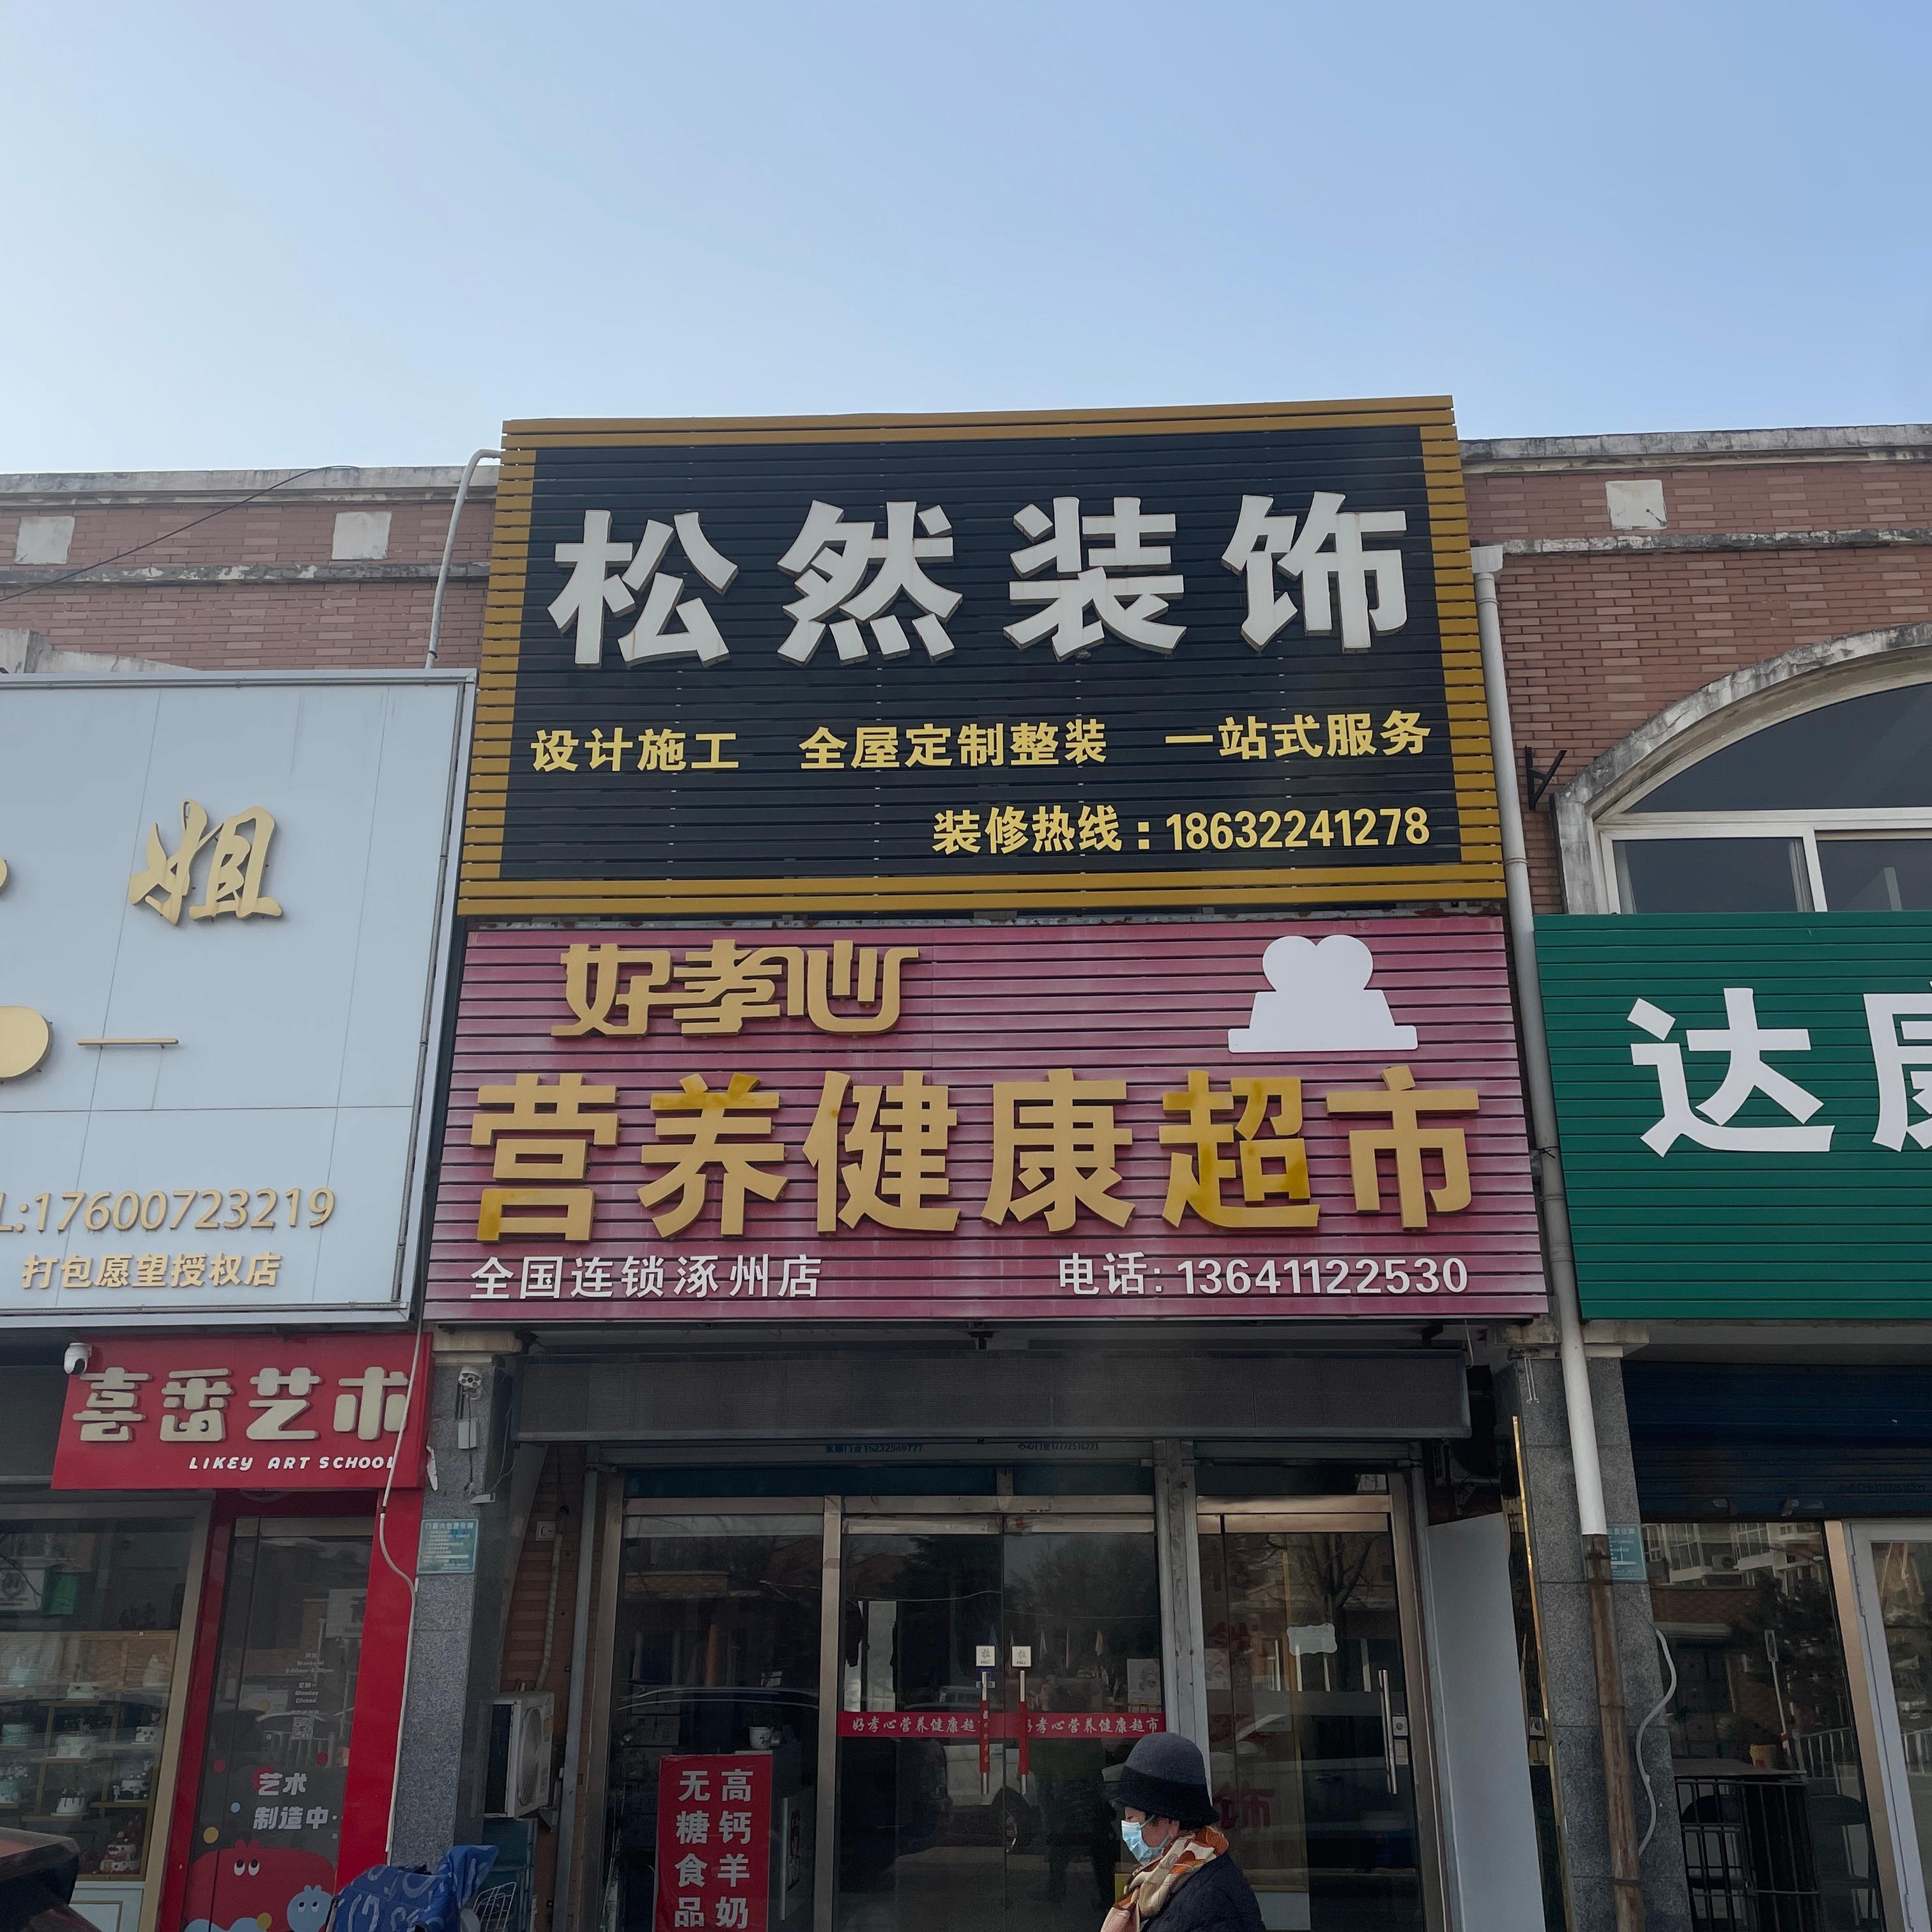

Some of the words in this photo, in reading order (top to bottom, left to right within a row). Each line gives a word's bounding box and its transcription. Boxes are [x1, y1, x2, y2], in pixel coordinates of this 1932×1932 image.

[548, 491, 1407, 669] 松然装饰
[531, 728, 739, 774] 设计施工
[799, 719, 1107, 770] 全屋定制整装
[1165, 710, 1431, 762] 一站式服务
[551, 939, 919, 1038] 好孝心
[470, 1065, 1480, 1242] 营养健康超市
[21, 1251, 283, 1289] 打包愿望授权店
[470, 1254, 822, 1300] 全国连锁涿州店
[189, 1457, 253, 1470] LIKEY
[267, 1457, 310, 1469] ART
[852, 1715, 988, 1733] 好孝心营养健康超
[257, 1772, 307, 1796] 艺术
[674, 1770, 710, 1927] 无糖食品
[715, 1768, 754, 1929] 高钙羊奶
